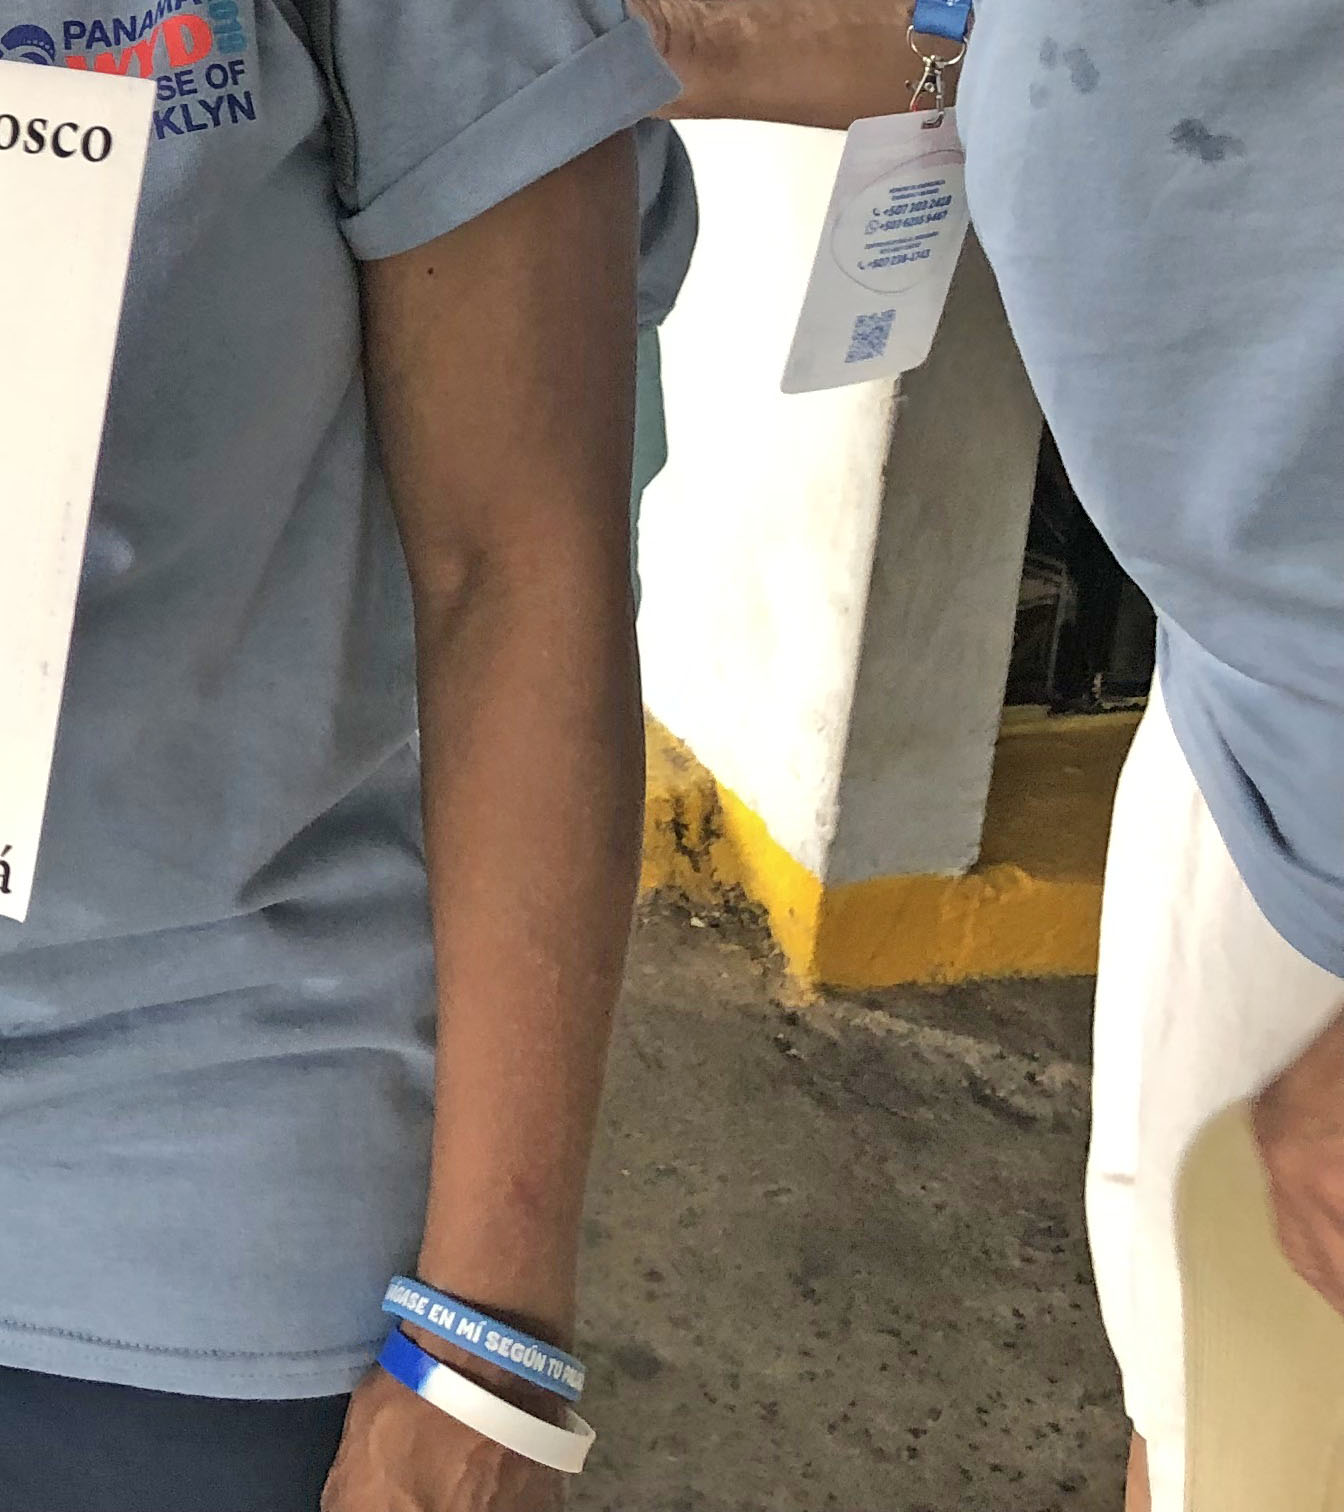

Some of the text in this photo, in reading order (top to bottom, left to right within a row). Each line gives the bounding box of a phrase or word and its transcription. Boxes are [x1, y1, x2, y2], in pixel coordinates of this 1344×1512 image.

[205, 59, 246, 90] OF
[152, 90, 256, 141] KLYN
[427, 1303, 456, 1330] EN
[455, 1317, 488, 1344] MÍ
[484, 1331, 547, 1372] SEGÚN
[547, 1357, 564, 1380] TU
